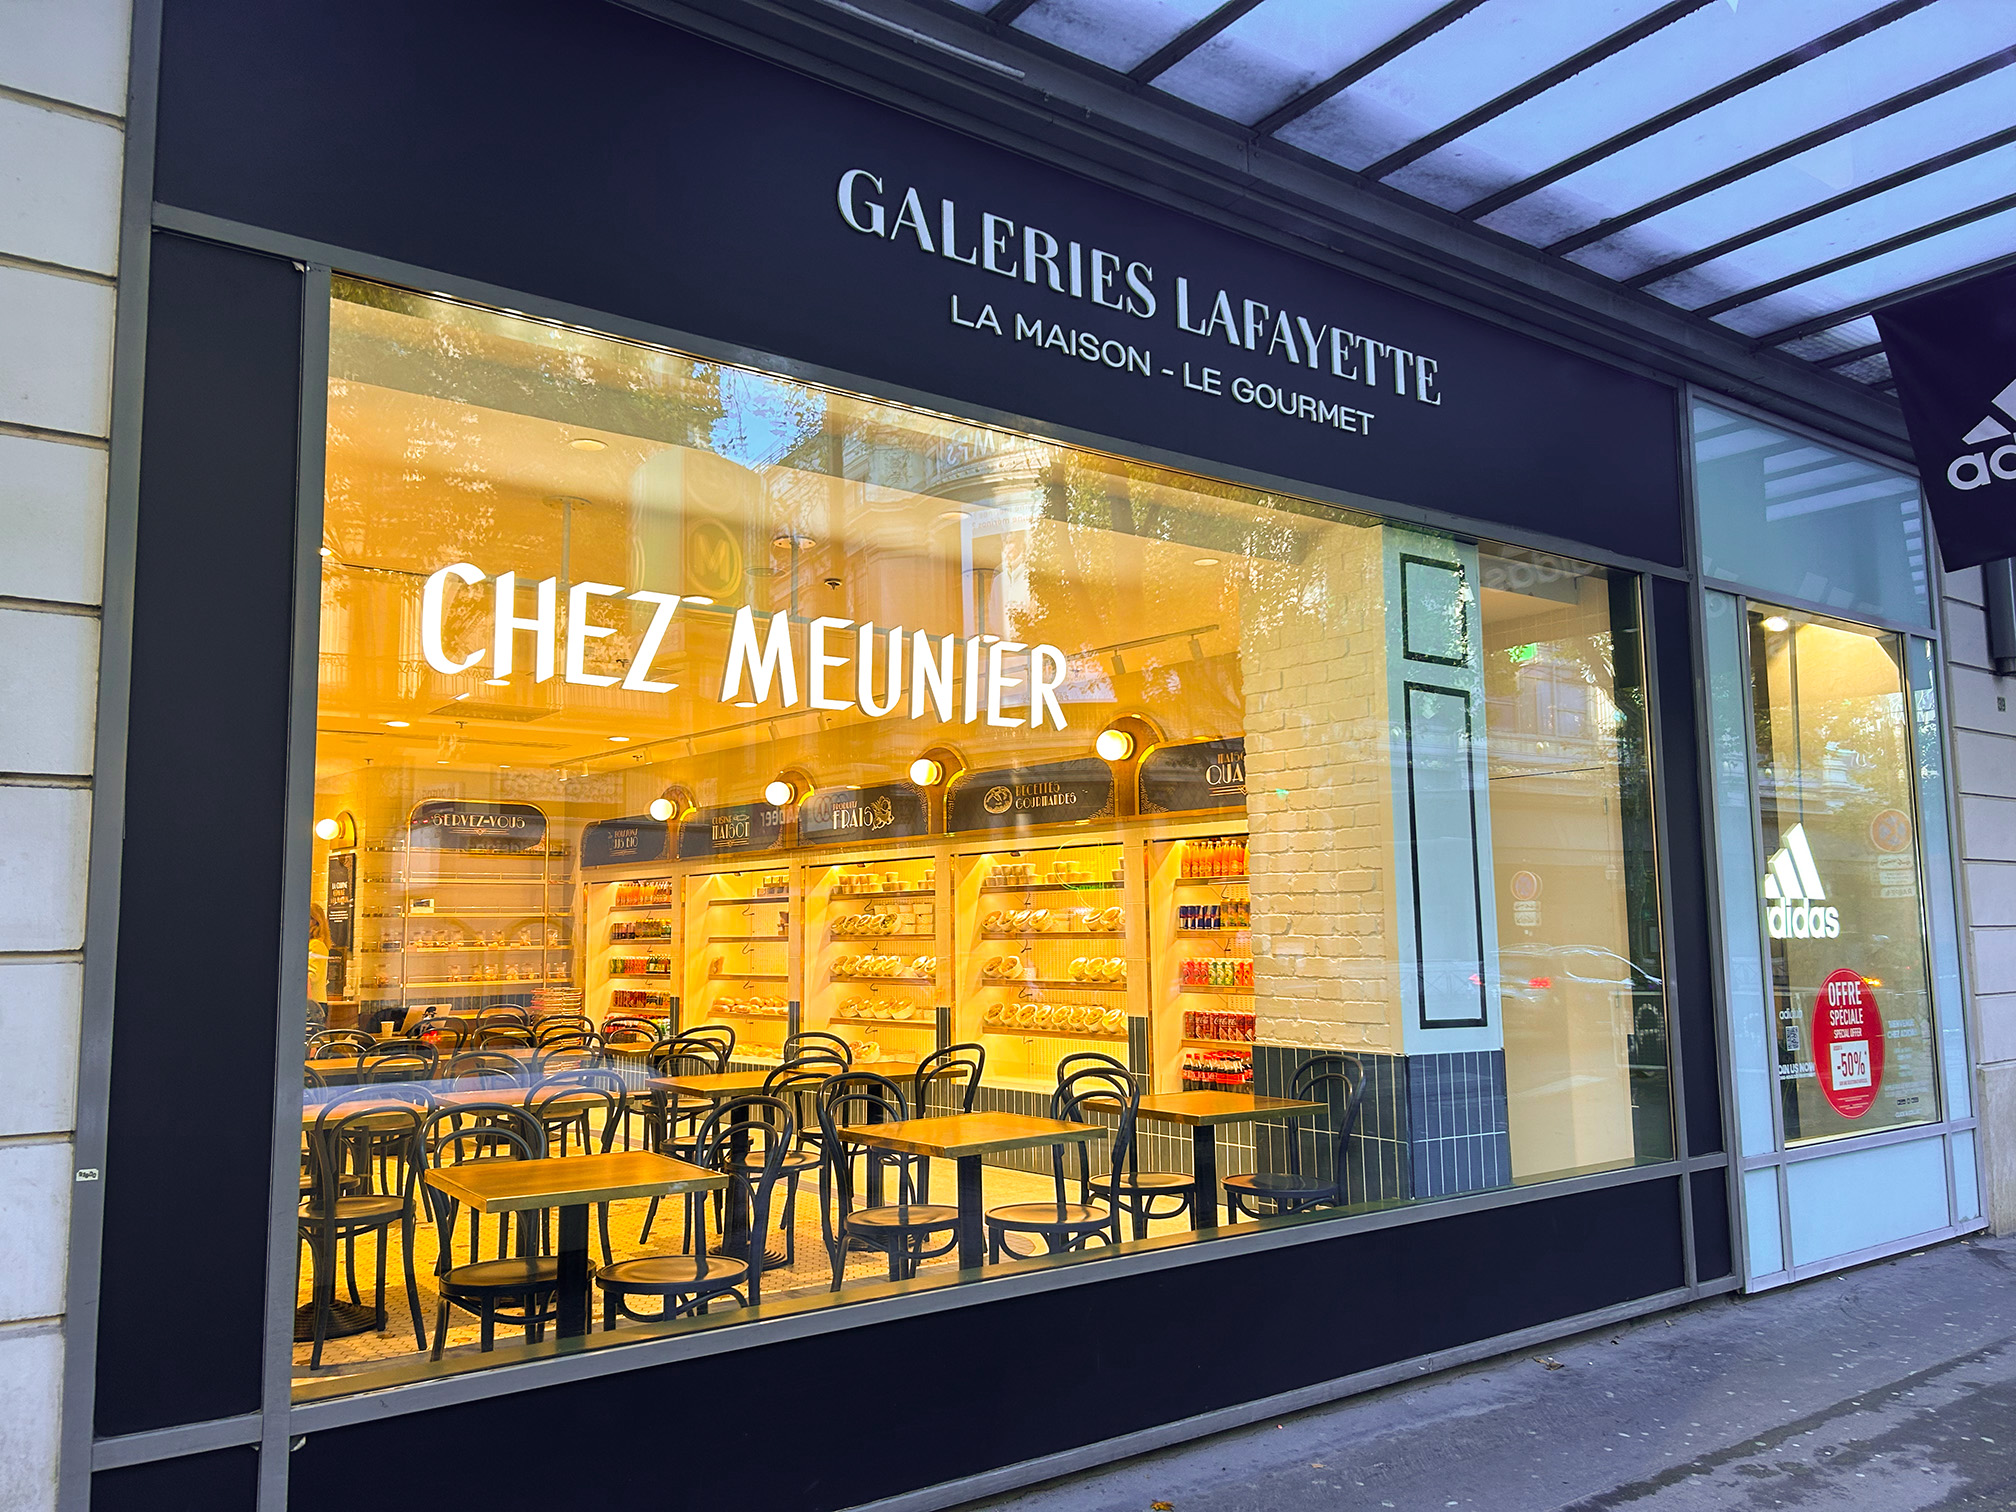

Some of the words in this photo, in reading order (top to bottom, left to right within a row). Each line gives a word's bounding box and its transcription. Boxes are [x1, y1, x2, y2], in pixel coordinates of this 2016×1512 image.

[836, 168, 1156, 319] GALERIES
[1176, 276, 1441, 406] LAFAYETTE
[951, 294, 1002, 336] LA
[1016, 312, 1152, 377] MAISON
[1183, 361, 1222, 396] LE
[1231, 377, 1376, 436] GOURMET
[421, 562, 681, 695] CHEZ
[718, 603, 1069, 732] MEUNIER
[1015, 781, 1060, 797] RECETTES
[1015, 792, 1077, 810] GOURMANDES
[432, 813, 526, 829] SERVEZ-VOUS
[833, 807, 874, 830] FRAIS
[1766, 897, 1840, 939] didas
[1828, 981, 1862, 1007] OFFRE
[1830, 1005, 1864, 1026] SPÉCIALE
[1834, 1029, 1850, 1039] SPECIAL
[1850, 1027, 1862, 1037] OFFER
[1779, 1064, 1790, 1075] OIN
[1790, 1063, 1799, 1074] US
[1800, 1062, 1815, 1073] NOW
